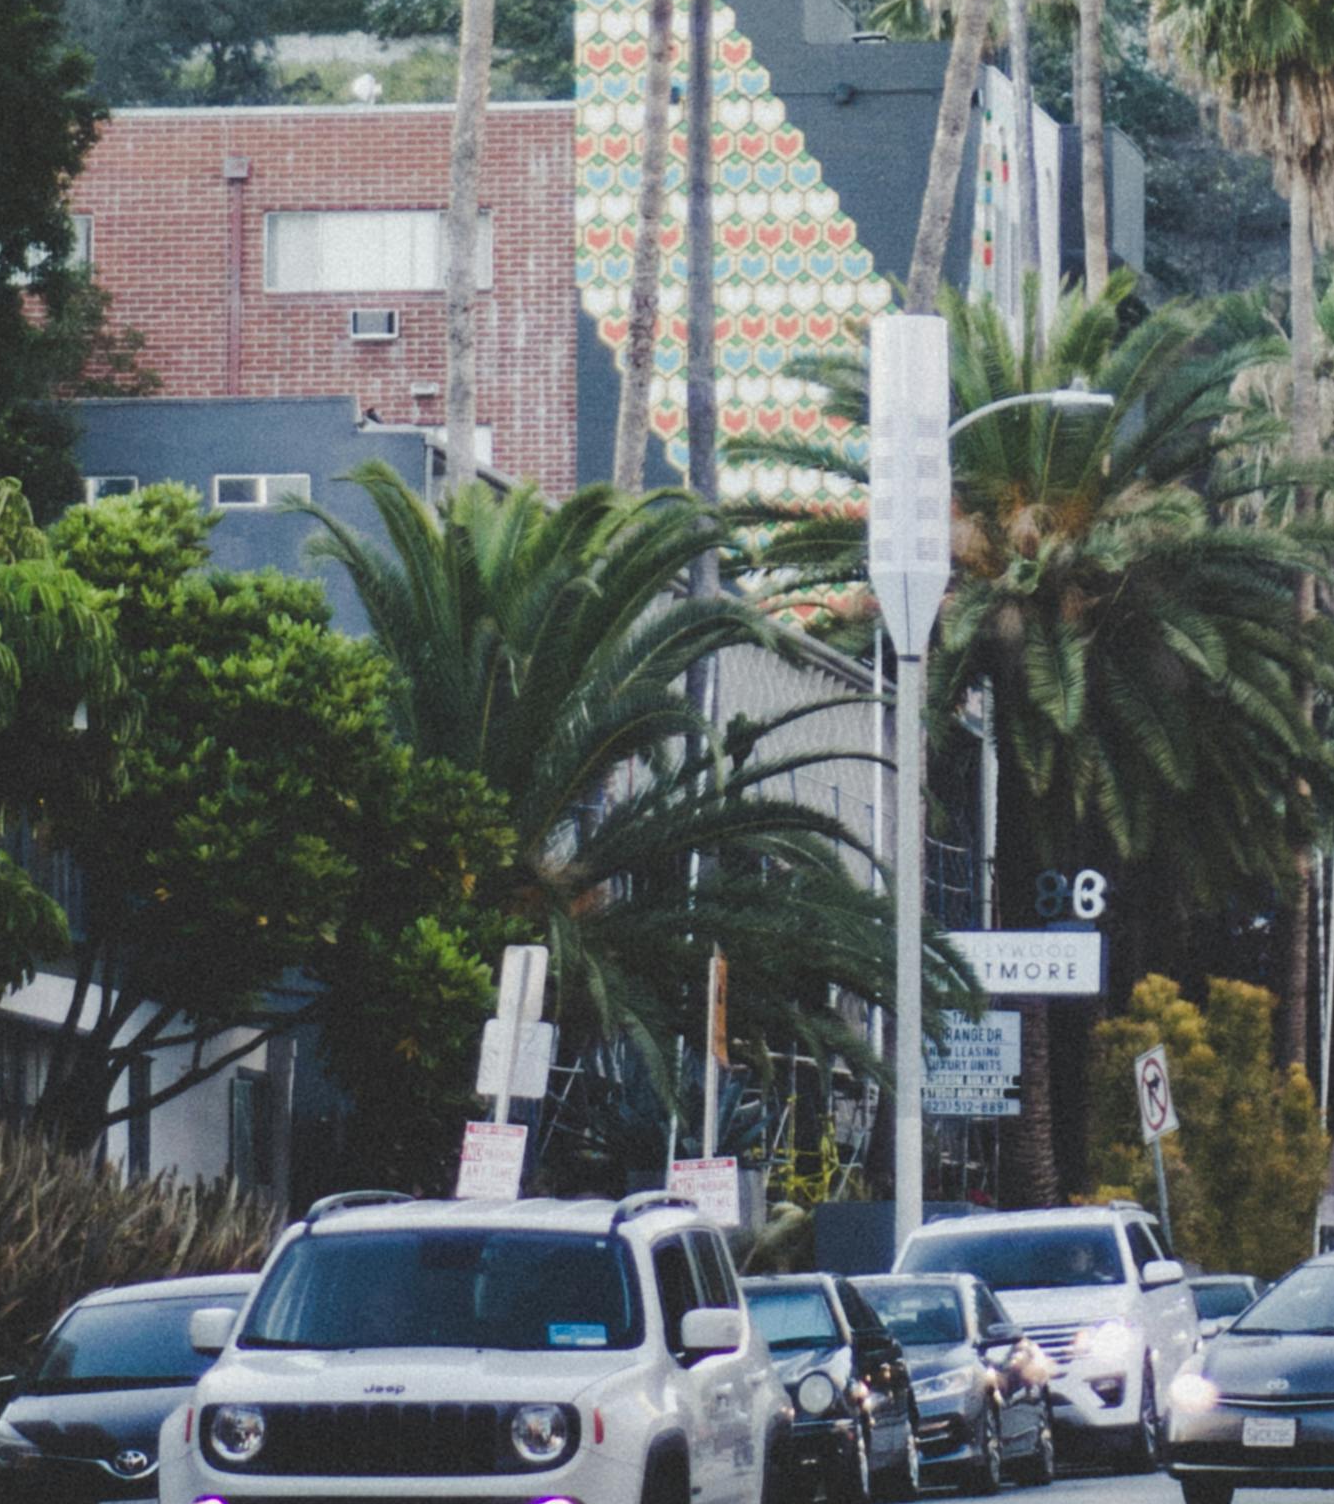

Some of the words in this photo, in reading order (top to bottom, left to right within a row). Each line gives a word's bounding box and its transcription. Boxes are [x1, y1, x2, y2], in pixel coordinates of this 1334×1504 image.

[984, 962, 1077, 980] TMORE
[943, 1027, 984, 1042] RANGE
[930, 1059, 968, 1072] UXURY
[363, 1384, 406, 1395] Jeep
